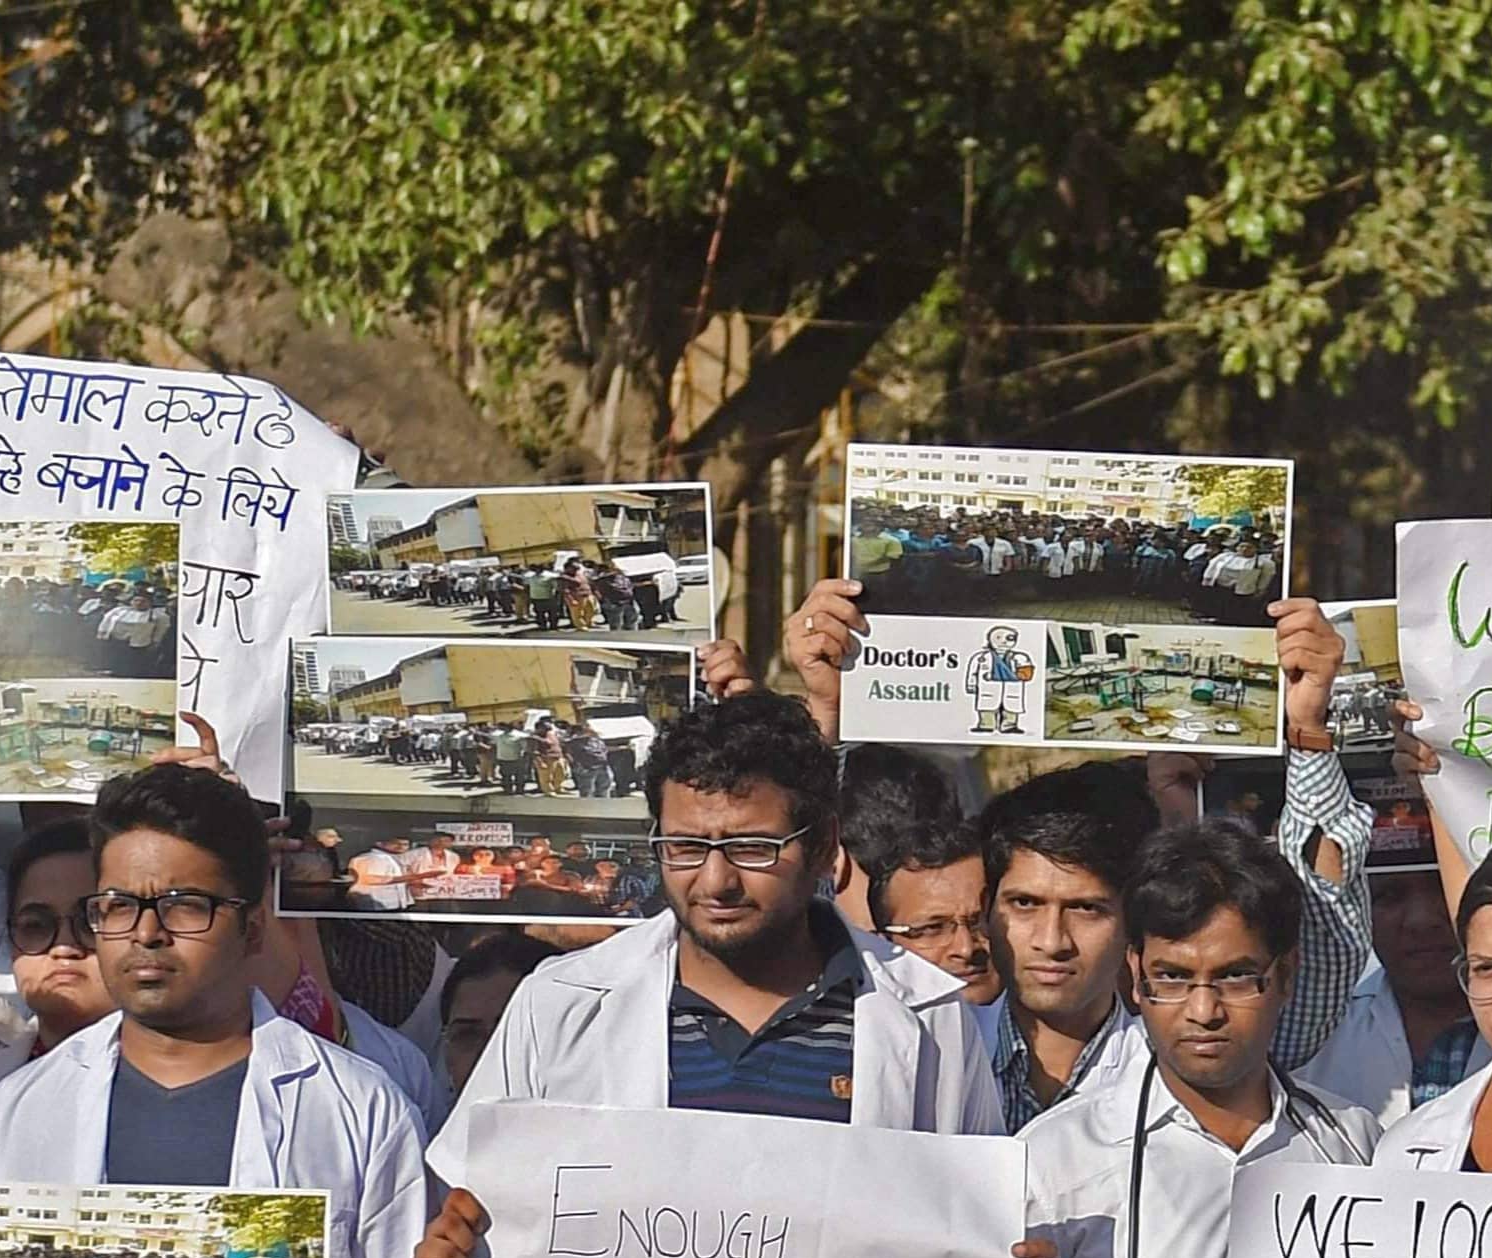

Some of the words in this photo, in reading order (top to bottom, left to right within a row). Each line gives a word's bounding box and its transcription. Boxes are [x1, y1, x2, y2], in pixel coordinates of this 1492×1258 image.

[144, 374, 267, 446] करते
[159, 451, 206, 518] के
[218, 467, 300, 533] लिये
[864, 646, 959, 669] Doctor's
[868, 678, 952, 702] Assault
